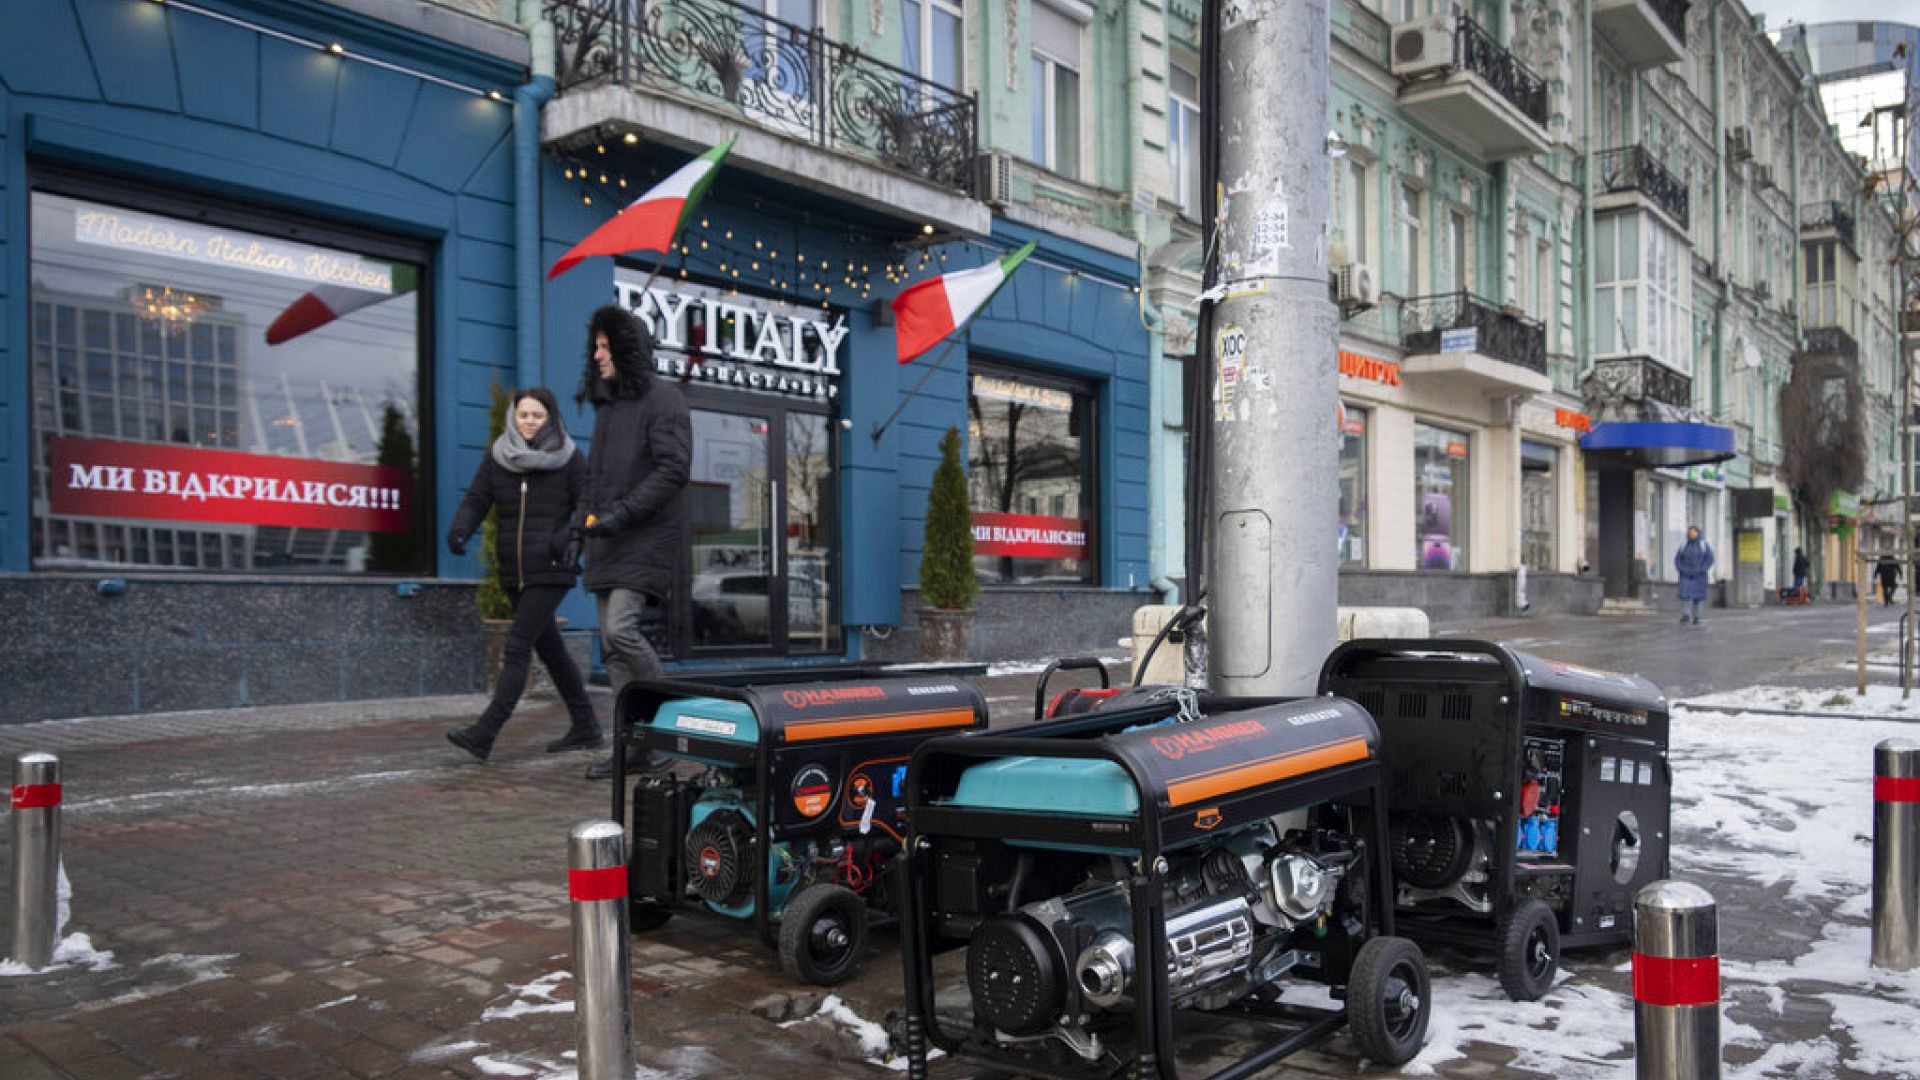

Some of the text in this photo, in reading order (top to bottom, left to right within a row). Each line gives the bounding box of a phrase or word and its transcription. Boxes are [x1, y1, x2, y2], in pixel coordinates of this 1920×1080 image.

[77, 209, 391, 289] Modern Italian Kitchen
[68, 463, 401, 511] МИ ВІДКРИЛИСЯ!!!
[993, 525, 1085, 546] ВІДКРИЛИСЯ!!!
[1172, 719, 1265, 753] HAMMER
